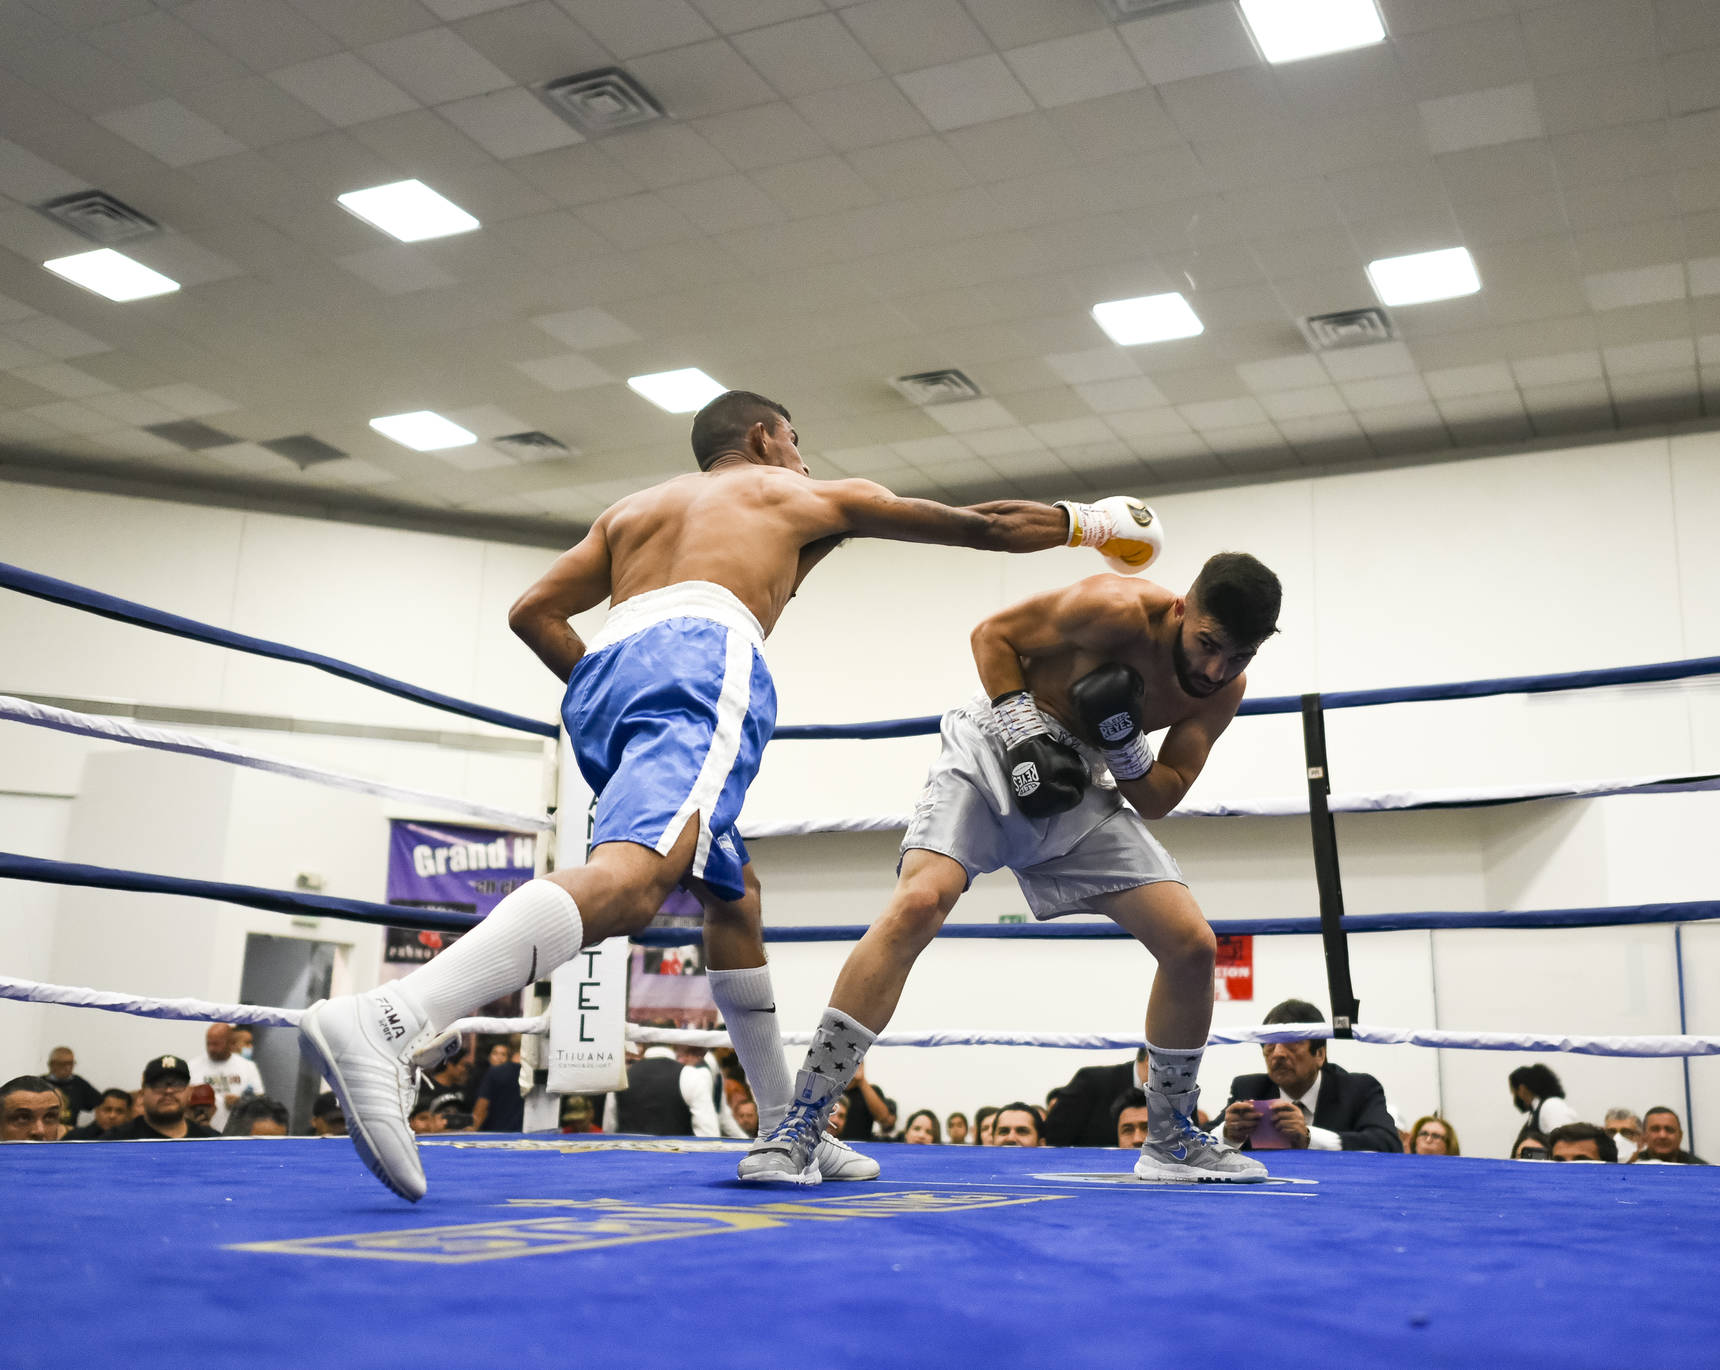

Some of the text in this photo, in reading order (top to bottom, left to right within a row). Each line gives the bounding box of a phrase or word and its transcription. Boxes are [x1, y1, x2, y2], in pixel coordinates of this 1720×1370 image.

[1099, 719, 1133, 739] REYES
[1012, 764, 1039, 792] REYES
[413, 838, 507, 878] Grand
[578, 942, 602, 1042] TEL
[375, 996, 406, 1040] FAMA
